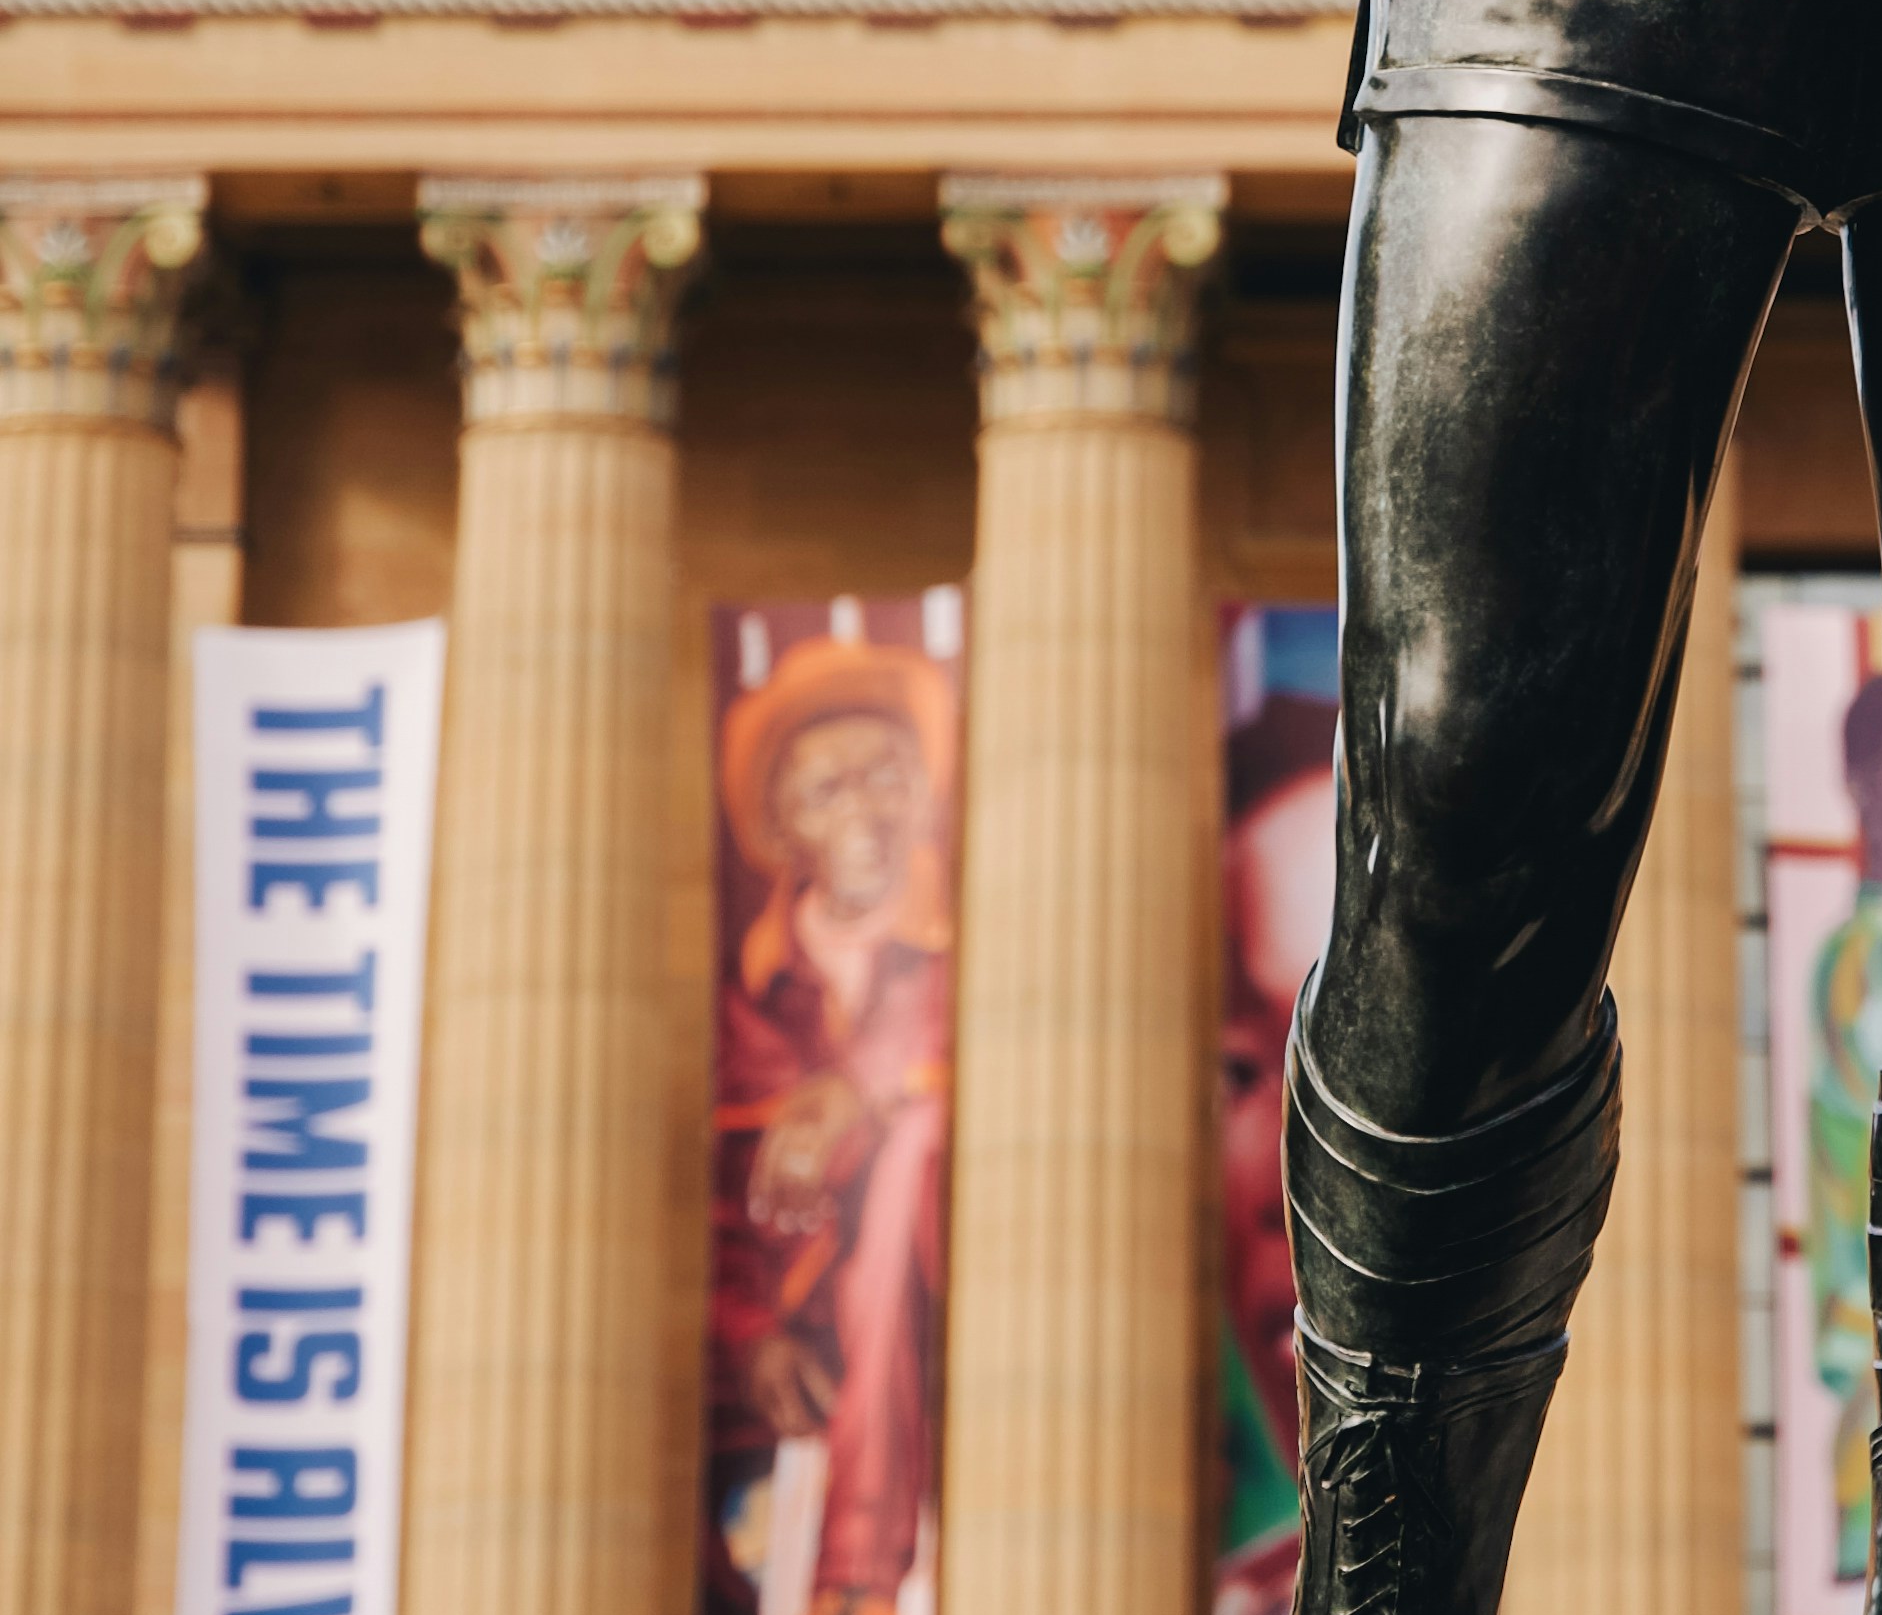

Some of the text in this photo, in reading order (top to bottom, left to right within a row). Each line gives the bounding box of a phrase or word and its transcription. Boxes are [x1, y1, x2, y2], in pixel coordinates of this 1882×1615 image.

[246, 685, 386, 913] THE
[237, 951, 378, 1245] TIME
[232, 1284, 366, 1407] IS
